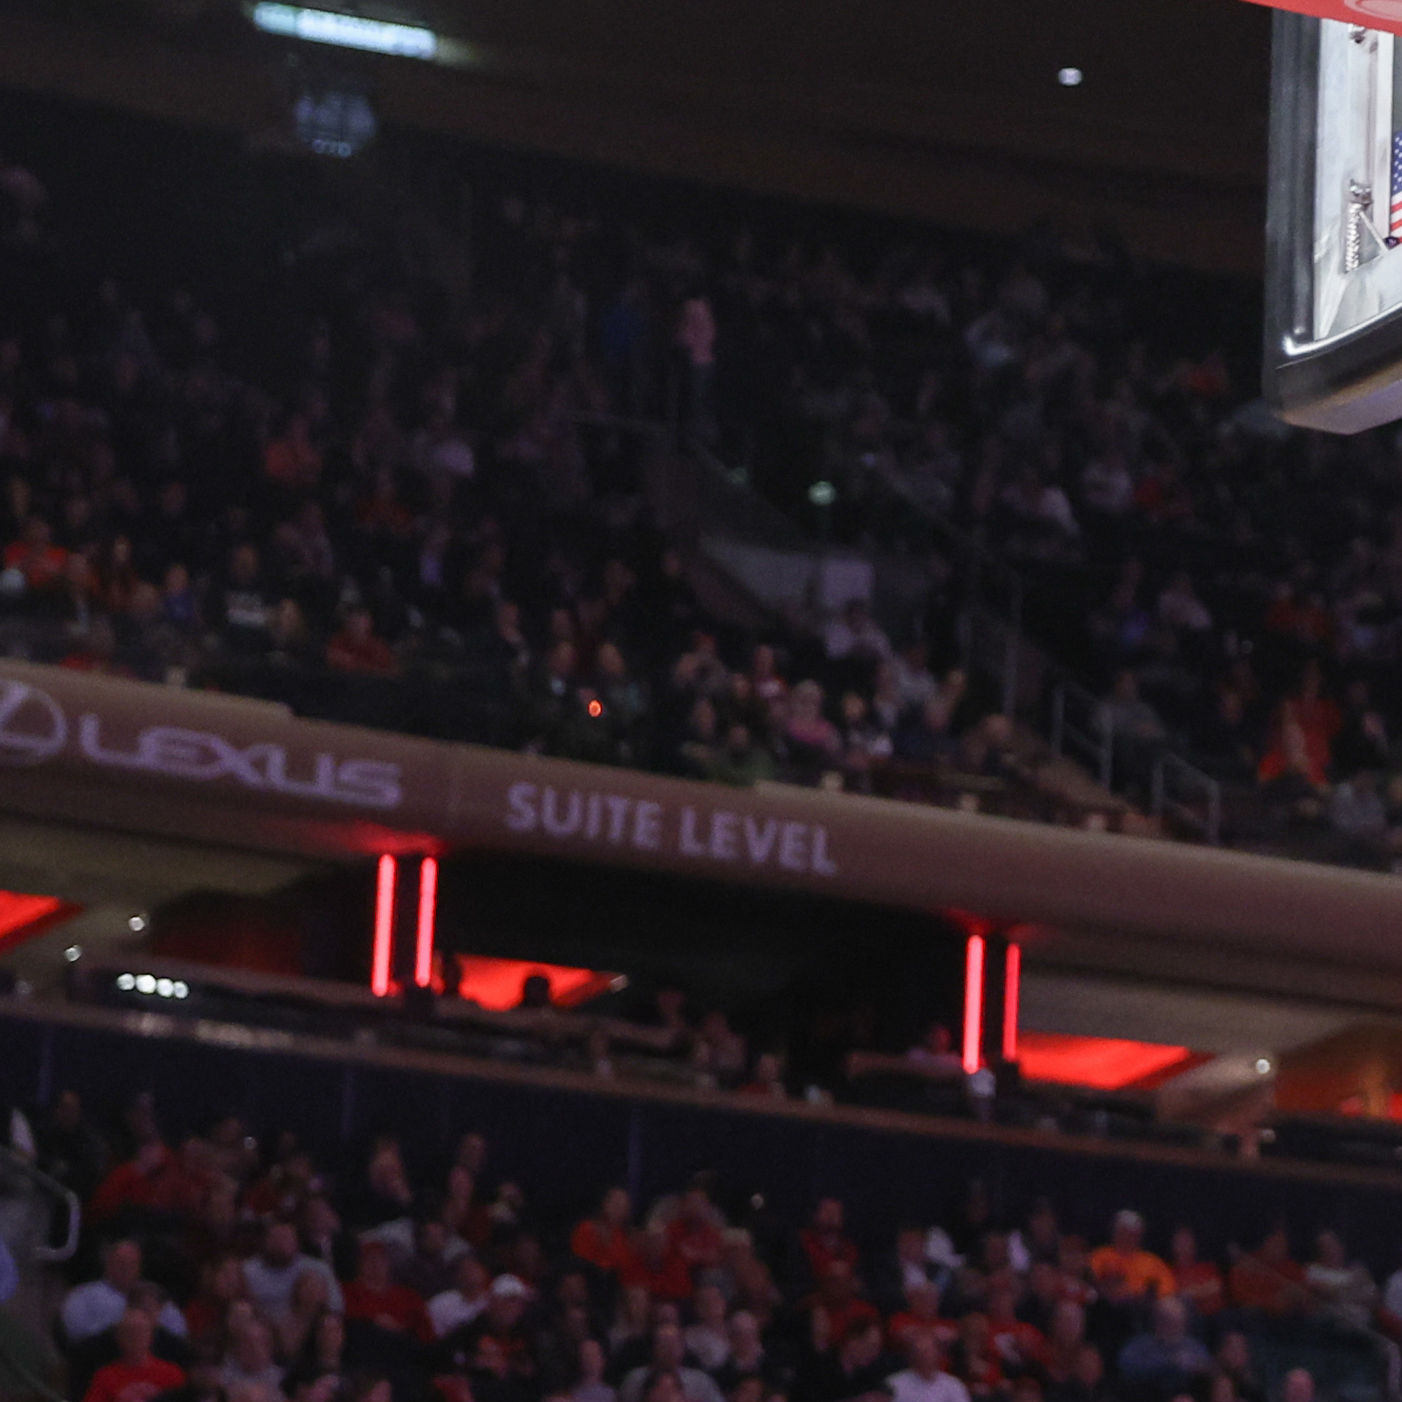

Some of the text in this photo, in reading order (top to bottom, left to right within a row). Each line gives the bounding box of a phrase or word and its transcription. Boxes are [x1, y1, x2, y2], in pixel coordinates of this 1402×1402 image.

[79, 713, 402, 809] LEXUS
[505, 781, 837, 877] SUITE LEVEL
